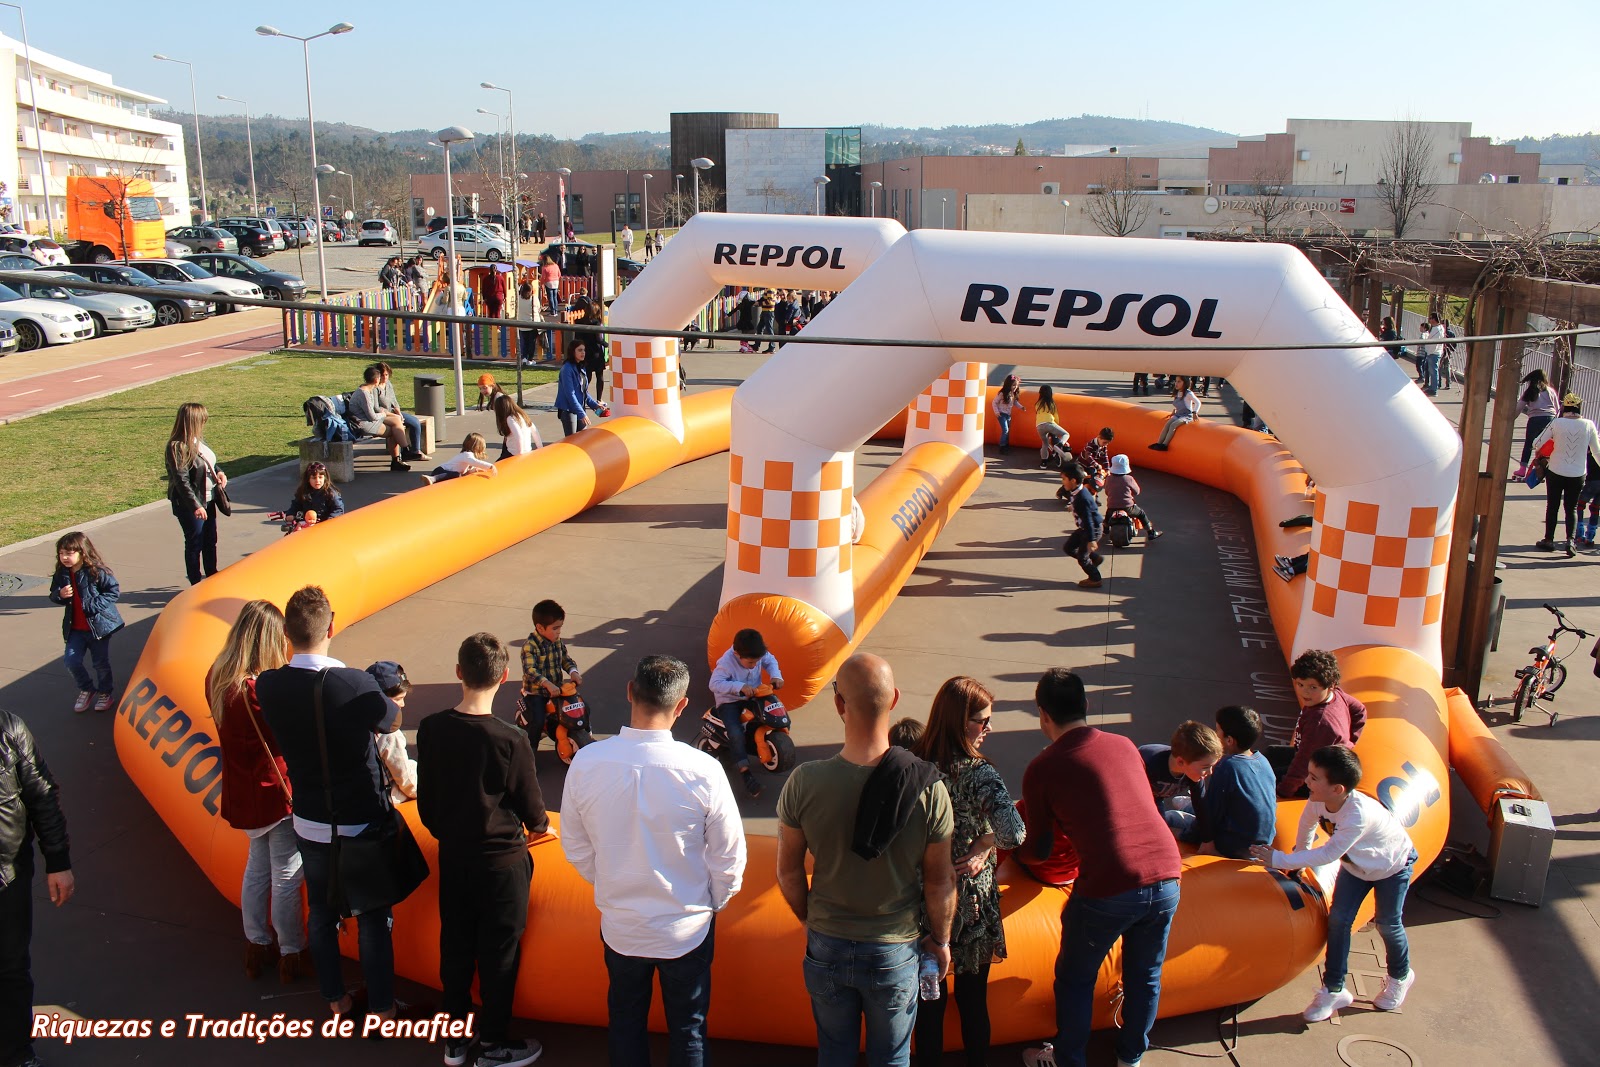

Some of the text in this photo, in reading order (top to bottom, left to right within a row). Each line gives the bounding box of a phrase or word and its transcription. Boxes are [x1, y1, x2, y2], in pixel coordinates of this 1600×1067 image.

[713, 242, 846, 270] REPSOL
[959, 282, 1223, 340] REPSOL
[890, 483, 939, 542] REPSOL
